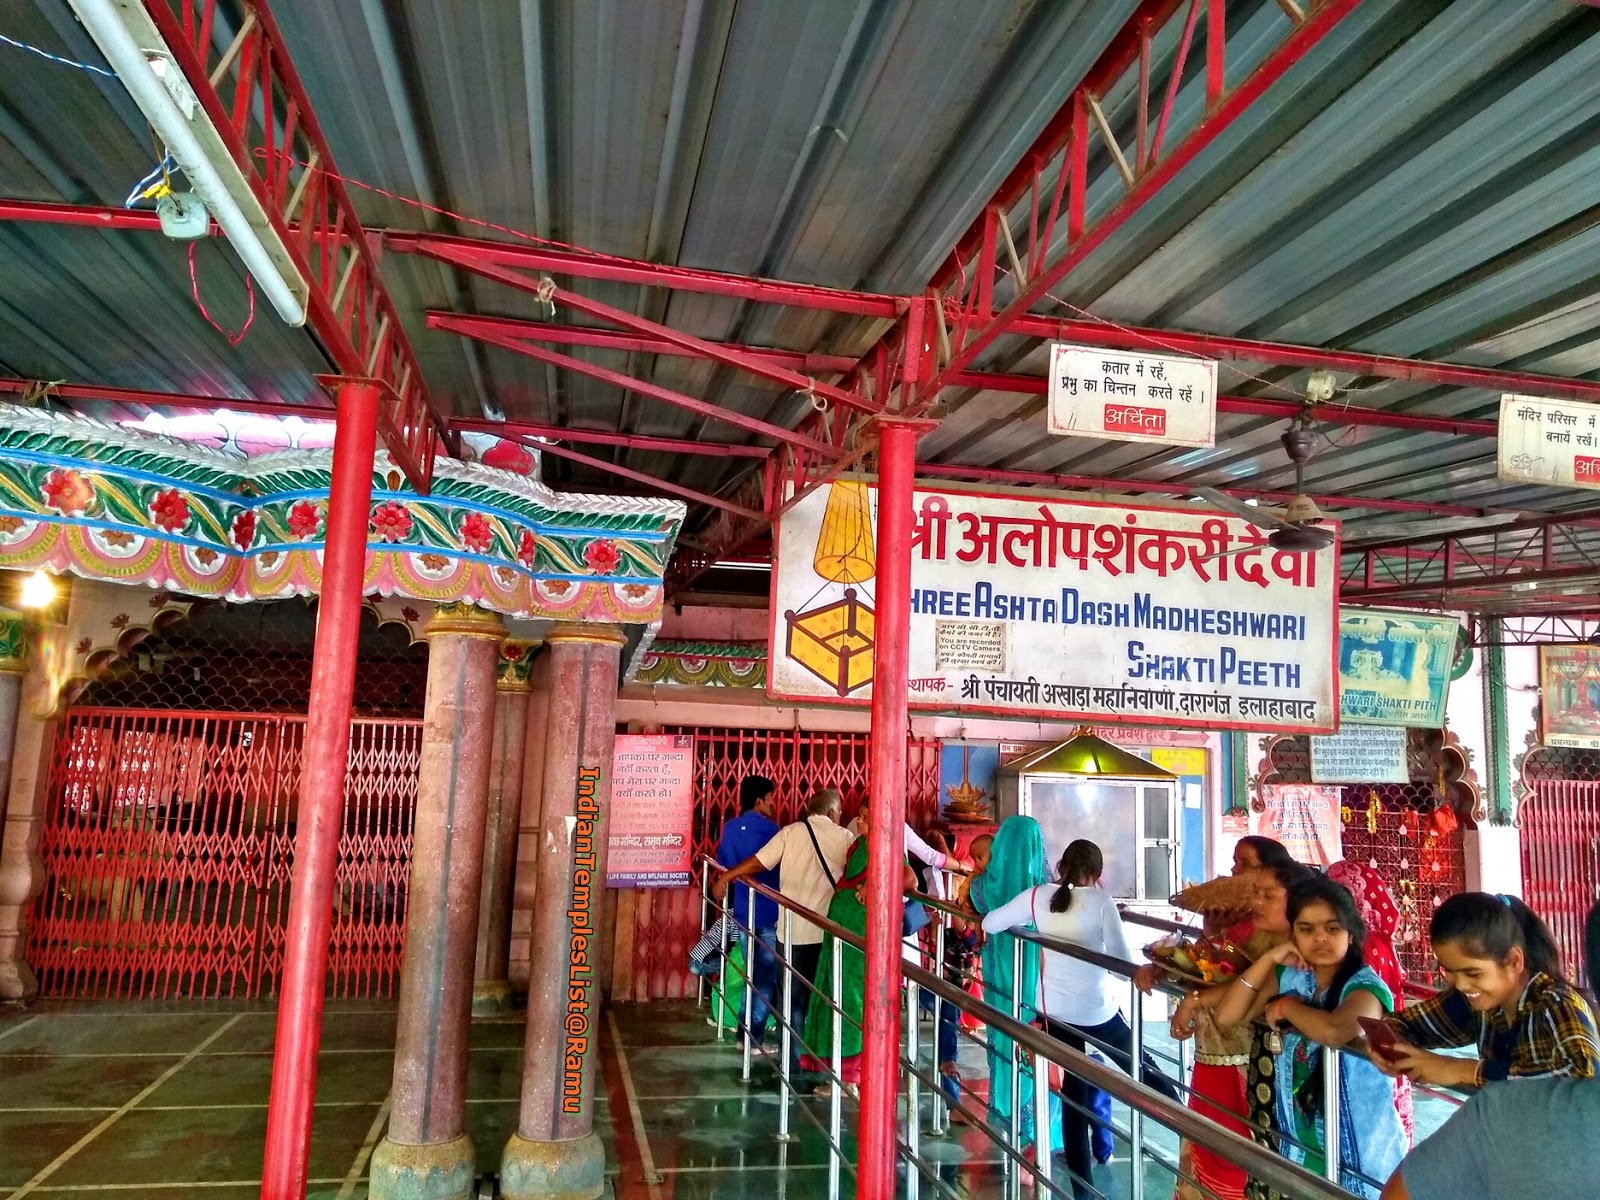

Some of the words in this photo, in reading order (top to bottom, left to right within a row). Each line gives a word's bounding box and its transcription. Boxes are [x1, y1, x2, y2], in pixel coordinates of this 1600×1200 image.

[1102, 360, 1130, 376] कतार
[1136, 360, 1144, 377] में
[1150, 362, 1167, 382] रहें,
[1062, 376, 1077, 395] प्रभु
[1084, 379, 1097, 393] का
[1104, 377, 1136, 396] चिन्तन
[1148, 383, 1172, 400] करते
[1105, 407, 1164, 429] अर्चिता
[1517, 406, 1541, 421] मंदिर
[1547, 410, 1577, 426] परिसर
[1588, 414, 1596, 428] में
[1546, 430, 1571, 444] बनायें
[910, 588, 971, 617] HREE
[1133, 592, 1306, 641] MADHESHWARI
[1127, 640, 1215, 683] SHAKTI
[1220, 646, 1301, 689] PEETH
[961, 674, 981, 699] श्री
[984, 675, 1040, 704] पंचायती
[1238, 696, 1316, 723] इलाहाबाद
[1340, 694, 1374, 706] HWARI
[1377, 697, 1411, 709] SHAKTI
[1414, 700, 1437, 711] PITH
[616, 763, 634, 773] नहीं
[636, 765, 659, 773] करता
[627, 775, 642, 785] मेरा
[616, 787, 633, 797] क्यों
[635, 787, 656, 797] करते
[662, 833, 682, 846] मन्दिर
